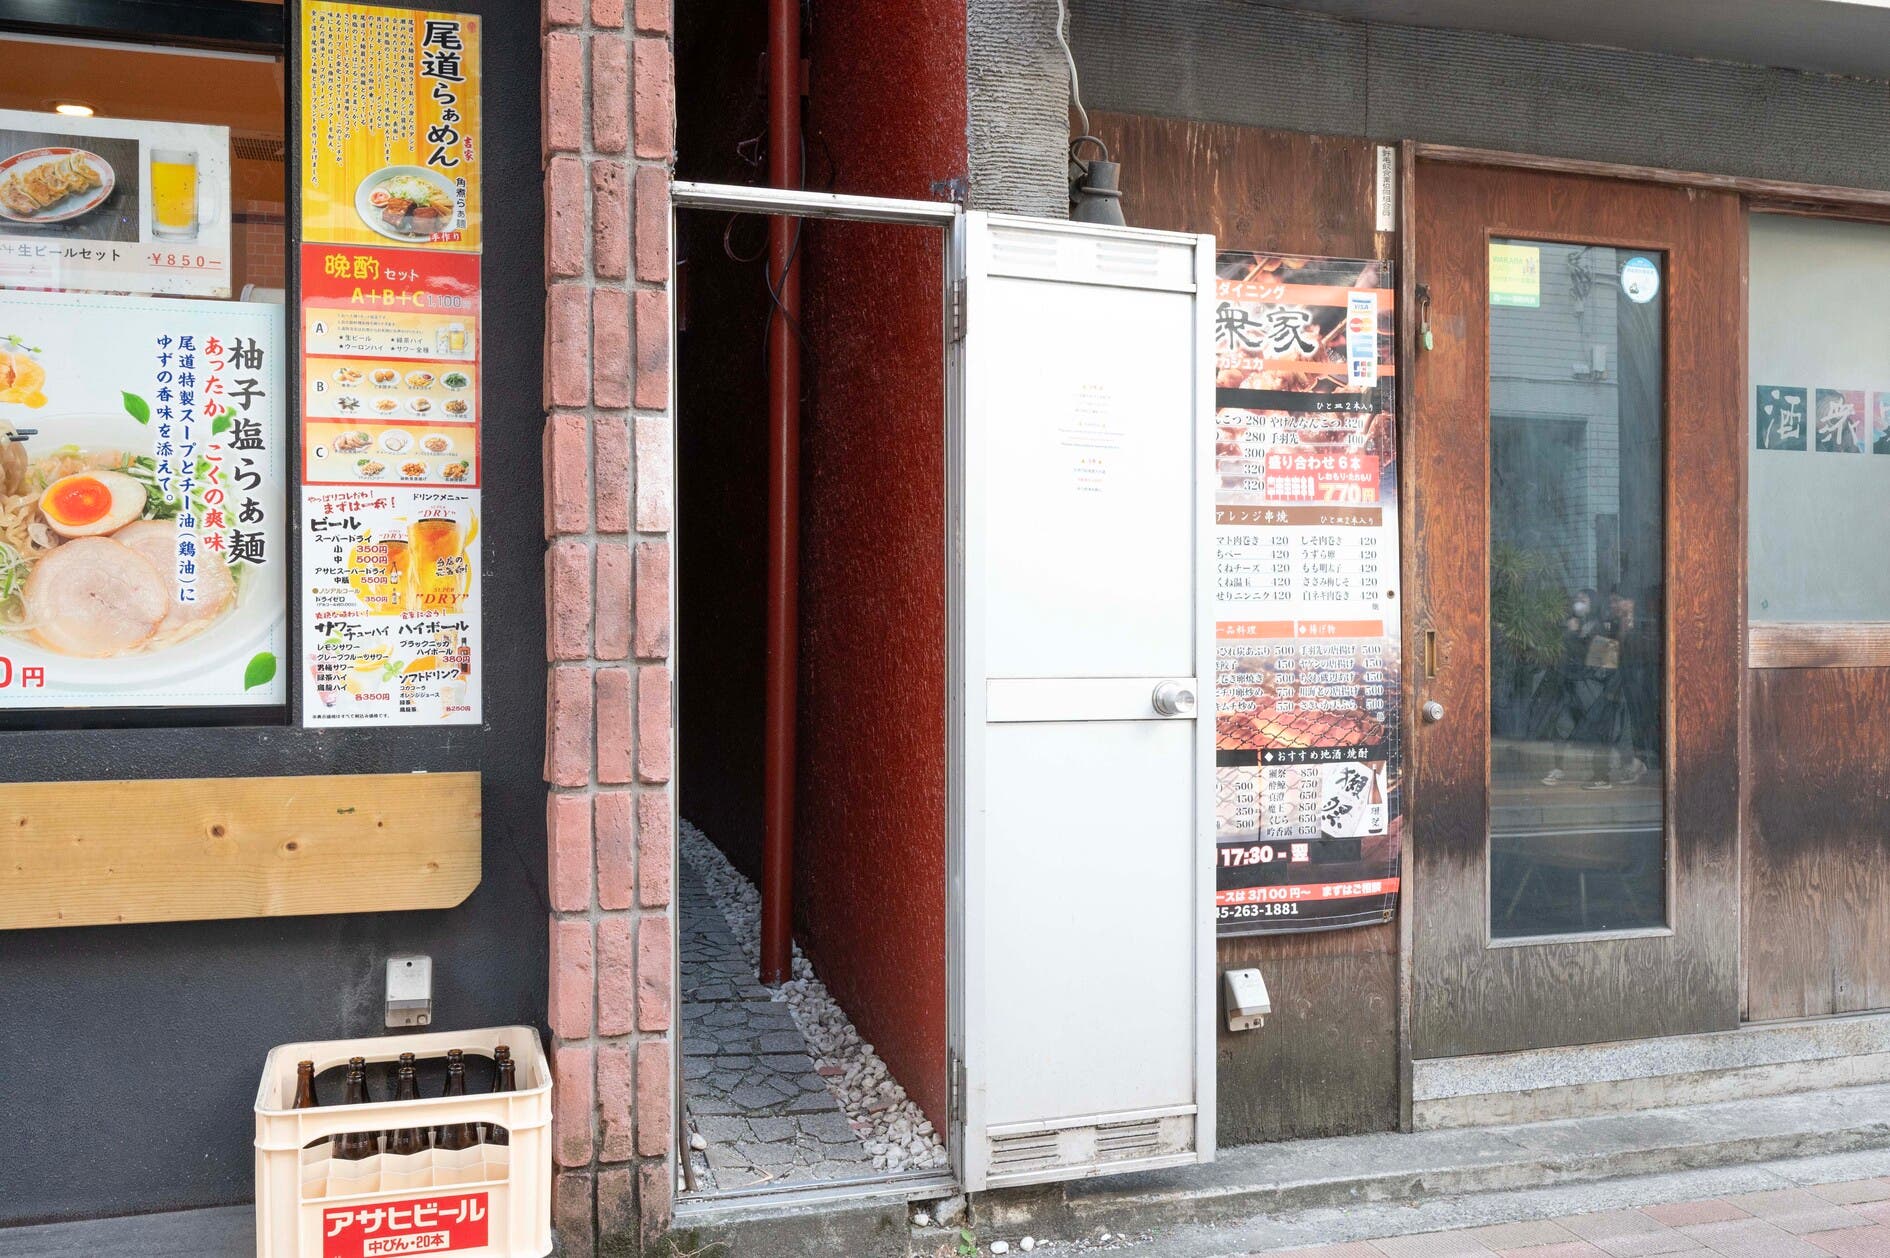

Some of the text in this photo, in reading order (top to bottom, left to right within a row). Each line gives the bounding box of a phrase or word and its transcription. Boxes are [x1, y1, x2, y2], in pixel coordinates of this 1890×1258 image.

[422, 20, 465, 168] 尾道らぁめん
[431, 232, 460, 242] 手作り
[316, 322, 324, 334] A
[344, 343, 384, 351] ウーロンハイ
[316, 381, 324, 392] B
[1316, 402, 1374, 412] ひと皿2本入り
[156, 336, 174, 503] ゆずの香味を添えて。
[1246, 416, 1266, 426] 280
[1344, 419, 1364, 429] 320
[1245, 432, 1266, 442] 280
[1272, 433, 1298, 444] 手羽先
[203, 336, 226, 552] あったか こくの爽味
[227, 337, 266, 564] 柚子塩らぁ麺
[316, 448, 324, 458] C
[1244, 448, 1265, 458] 300
[1268, 456, 1361, 470] 盛り合わせ6本
[1244, 464, 1264, 474] 320
[1244, 481, 1264, 490] 320
[1318, 483, 1376, 504] 770円
[1216, 510, 1288, 524] アレンジ串焼
[311, 516, 362, 532] ビール
[1271, 536, 1288, 545] 120
[1360, 537, 1377, 546] 120
[356, 545, 388, 553] 350円
[1272, 550, 1290, 559] 120
[1360, 550, 1377, 559] 120
[356, 556, 388, 564] 500円
[1272, 564, 1290, 573] 120
[1360, 564, 1378, 573] 120
[1273, 578, 1291, 587] 120
[1360, 578, 1378, 586] 120
[1274, 591, 1291, 600] 120
[1361, 591, 1378, 600] 120
[315, 620, 362, 636] サワー
[399, 620, 469, 635] ハイボール
[344, 626, 390, 641] チューハイ
[1275, 646, 1294, 655] 500
[1362, 645, 1381, 654] 500
[1276, 660, 1294, 669] 450
[1364, 658, 1382, 668] 450
[399, 669, 459, 683] ソフトドリンク
[1276, 674, 1294, 684] 500
[1365, 672, 1382, 681] 450
[1366, 686, 1383, 695] 500
[355, 693, 390, 701] 各350円
[1276, 702, 1294, 711] 550
[1277, 748, 1368, 762] おすすめ地酒・焼酎
[1300, 768, 1318, 778] 850
[1300, 780, 1317, 789] 750
[1236, 795, 1254, 803] 450
[1300, 791, 1317, 800] 650
[1236, 807, 1254, 815] 350
[1299, 803, 1317, 812] 850
[1236, 820, 1254, 828] 500
[1268, 815, 1317, 825] くじら 650
[1298, 826, 1317, 835] 650
[1221, 846, 1273, 866] 17:30
[1322, 882, 1382, 897] まずはご相談
[326, 1198, 485, 1237] アサヒビール
[368, 1234, 445, 1254] 中びん・20本
